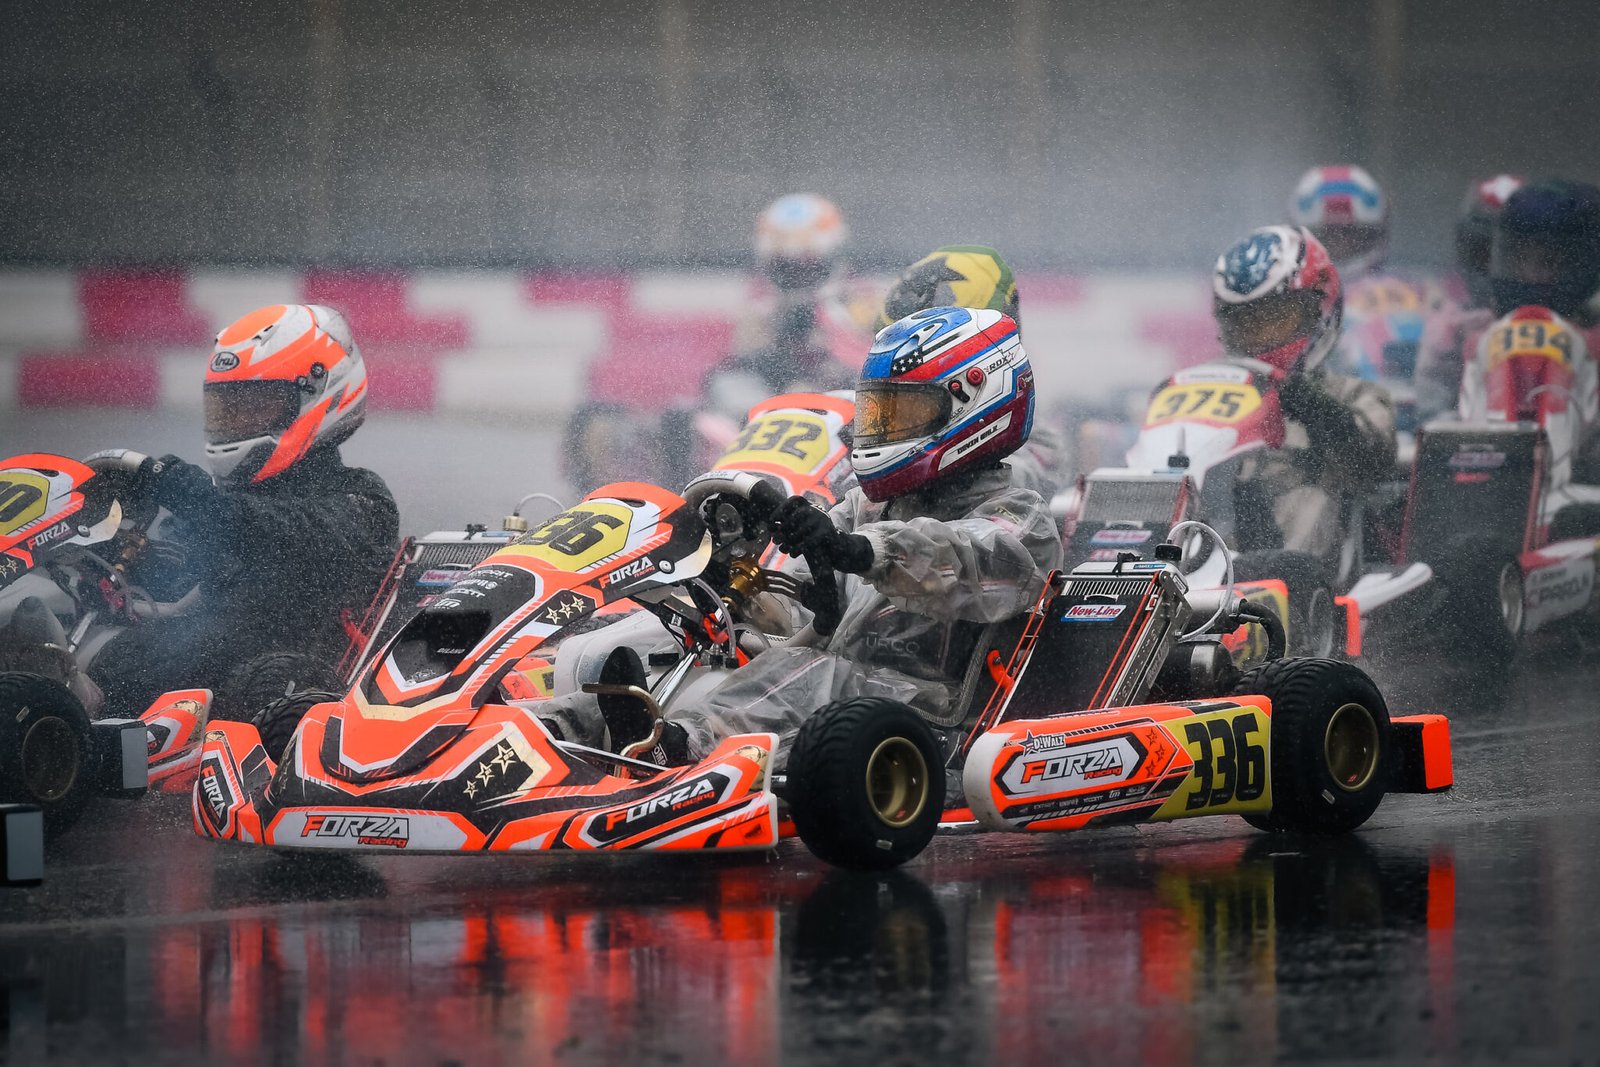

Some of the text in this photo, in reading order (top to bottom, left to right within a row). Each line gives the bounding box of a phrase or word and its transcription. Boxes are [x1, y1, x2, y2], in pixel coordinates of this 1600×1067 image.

[27, 521, 71, 551] FORZA
[598, 556, 653, 589] FORZA
[1067, 605, 1121, 617] New-Line
[653, 746, 666, 766] OMP
[1021, 747, 1124, 784] FORZA Racing
[1183, 713, 1266, 811] 336
[201, 765, 226, 819] FORZA
[606, 779, 715, 831] FORZA Racing
[300, 814, 410, 849] FORZA Racing
